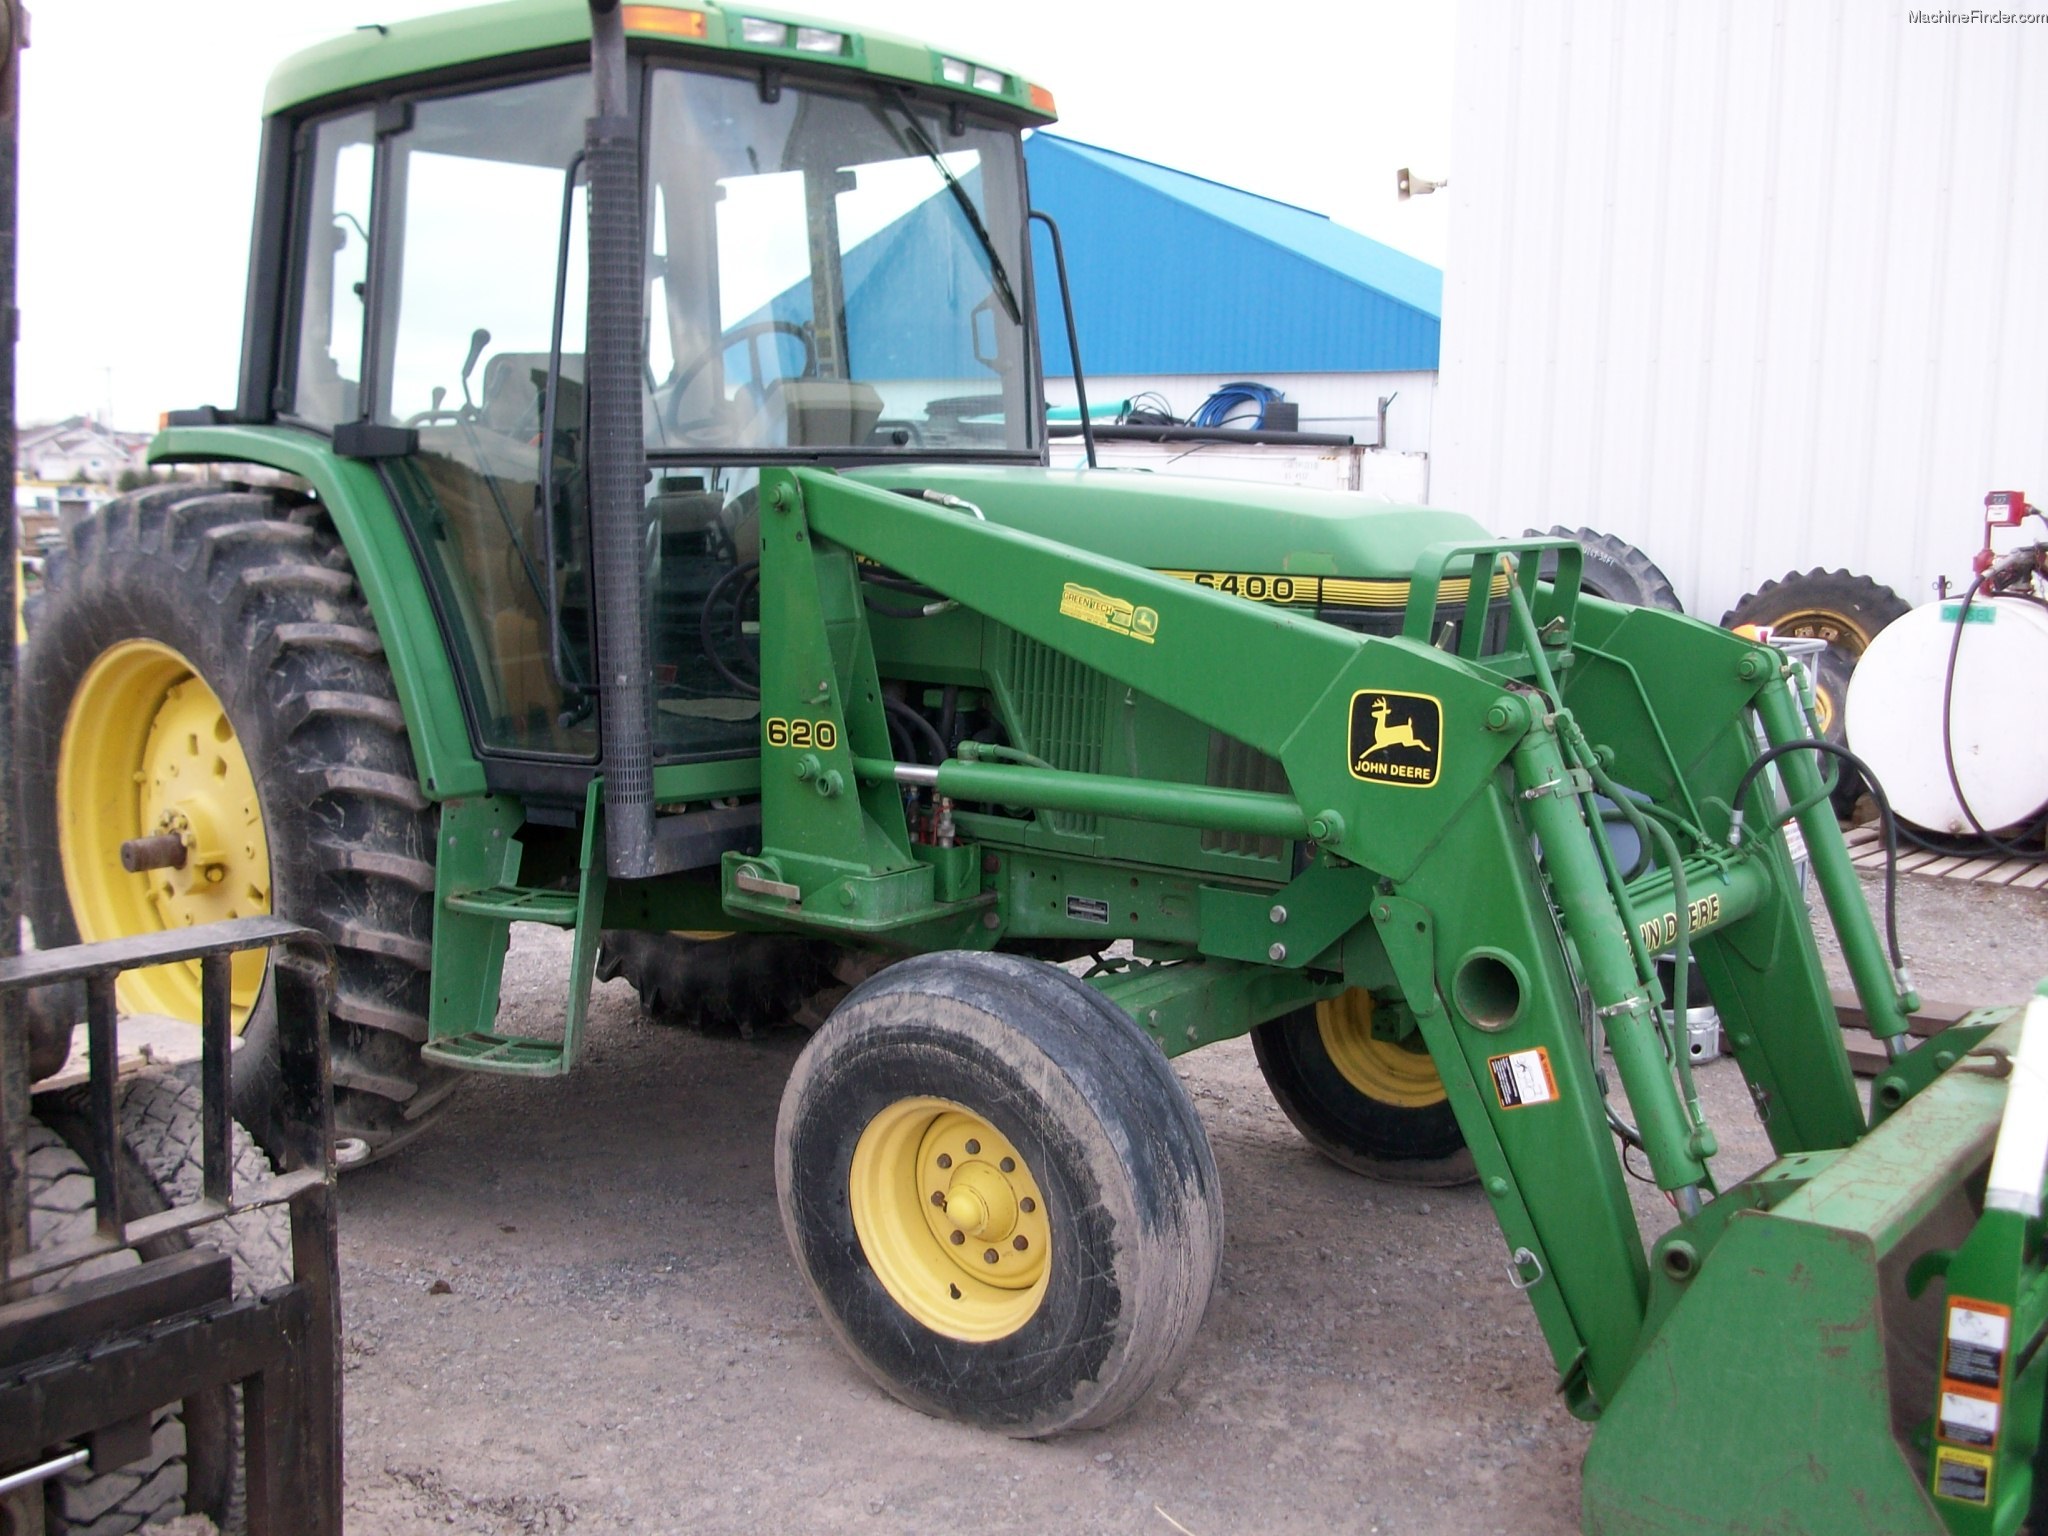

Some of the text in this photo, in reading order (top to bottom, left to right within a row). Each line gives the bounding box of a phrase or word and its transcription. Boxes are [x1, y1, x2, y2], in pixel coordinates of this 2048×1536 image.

[1941, 606, 1995, 622] DISEL
[766, 717, 837, 751] 620
[1354, 761, 1431, 780] JOHN DEERE
[1663, 893, 1720, 945] DERE
